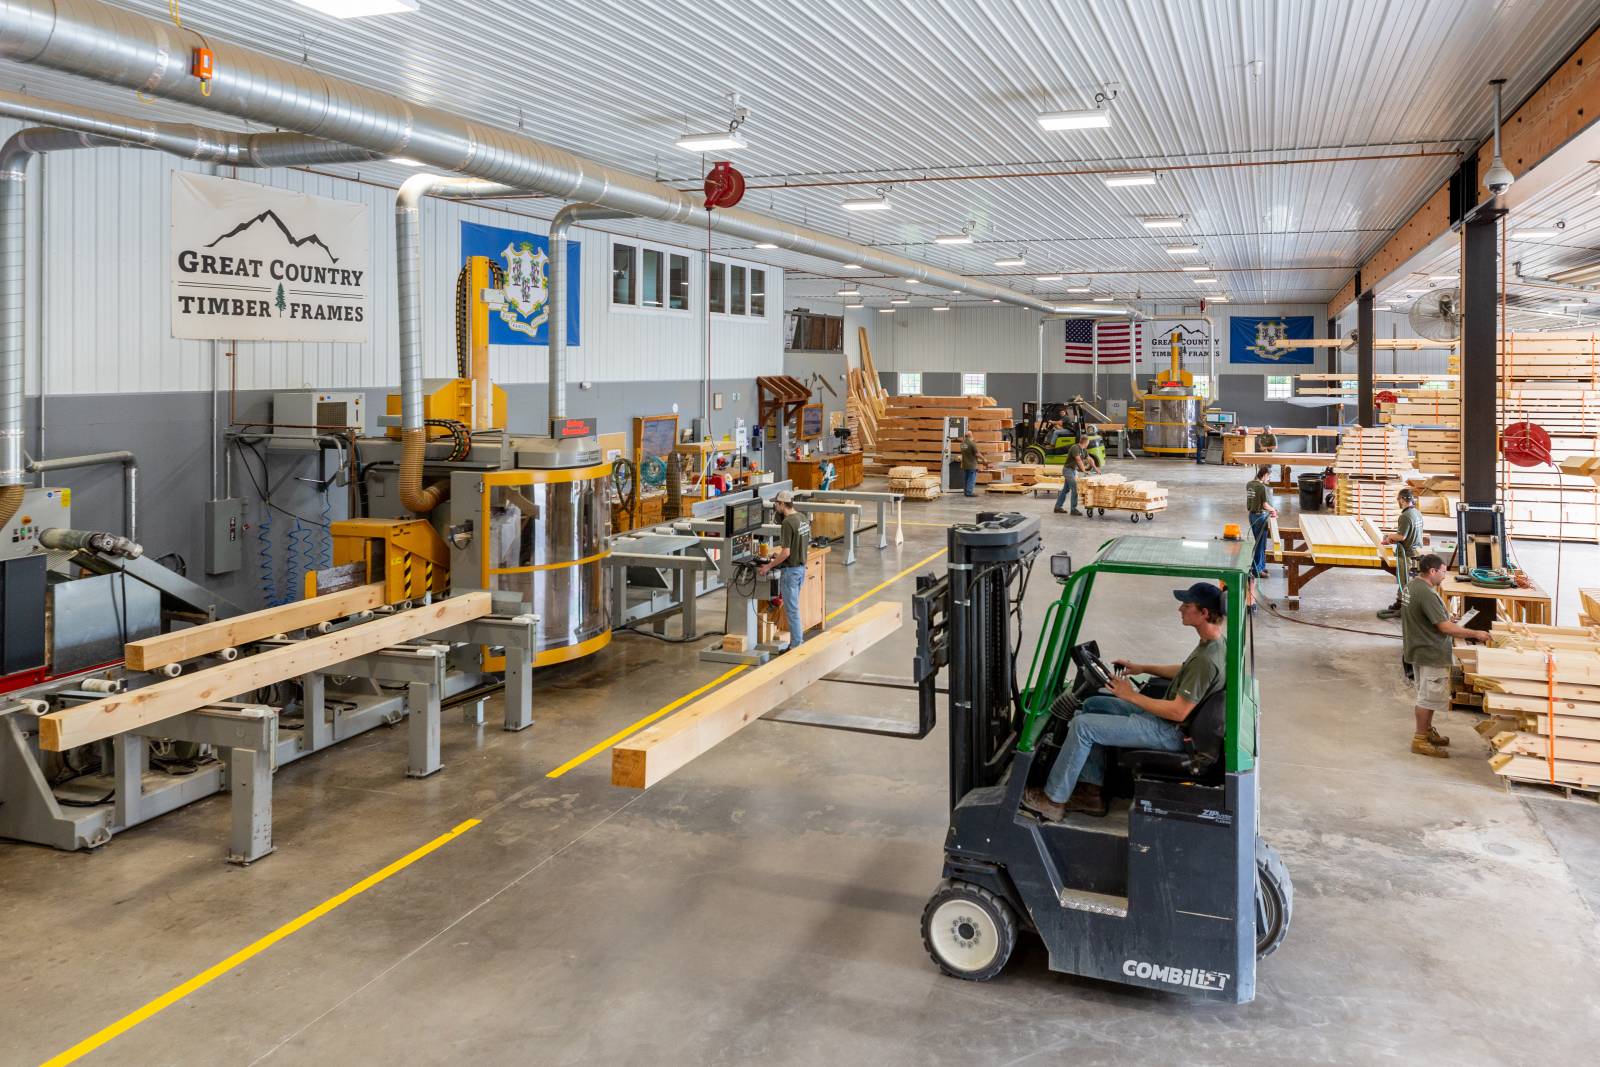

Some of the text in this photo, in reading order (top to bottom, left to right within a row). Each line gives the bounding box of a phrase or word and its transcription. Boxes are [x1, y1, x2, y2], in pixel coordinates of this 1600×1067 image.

[177, 250, 364, 287] GREAT COUNTRY
[177, 295, 364, 322] TIMBER FRAMES
